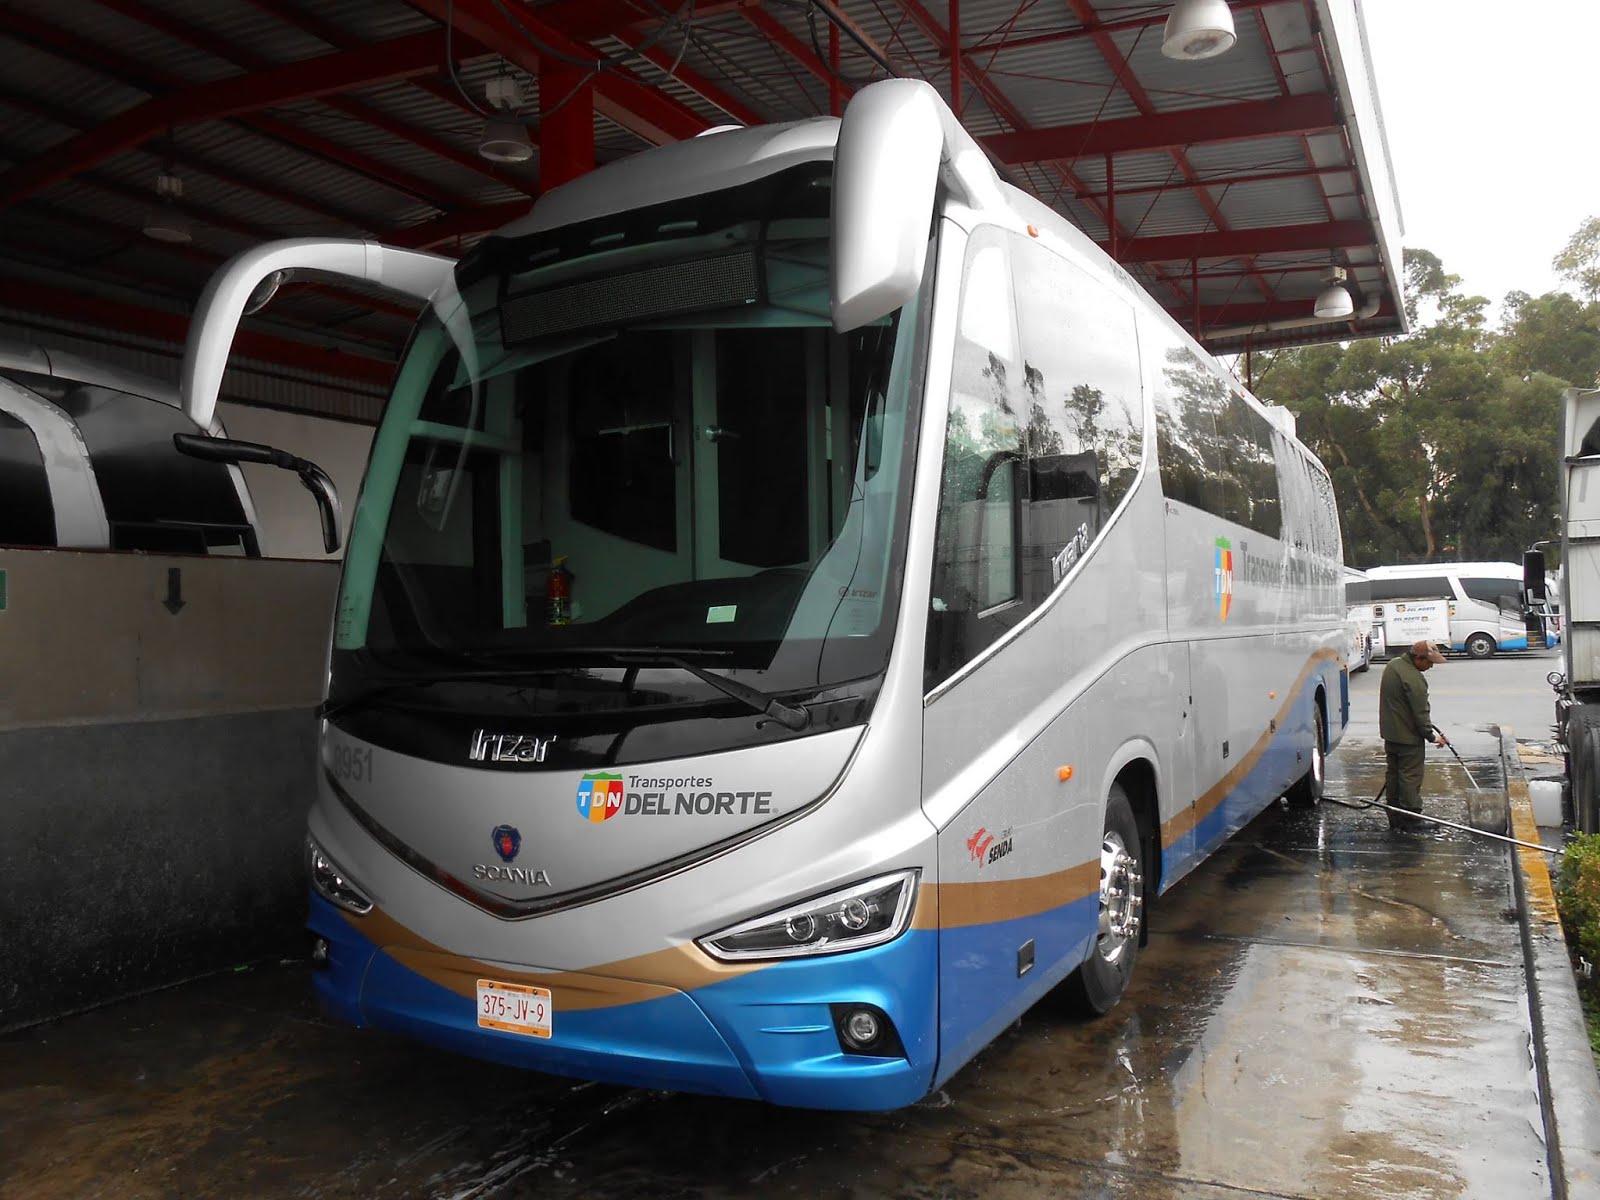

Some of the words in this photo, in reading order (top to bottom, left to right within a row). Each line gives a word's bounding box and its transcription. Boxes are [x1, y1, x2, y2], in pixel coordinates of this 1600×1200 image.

[1215, 568, 1232, 594] TDN
[628, 775, 713, 790] Transportes
[577, 791, 622, 808] TDN
[624, 792, 671, 815] DEL
[674, 791, 773, 815] NORTE
[988, 838, 1013, 864] SENDA
[472, 864, 552, 887] SCANIA
[483, 994, 544, 1022] 375-JV-9
